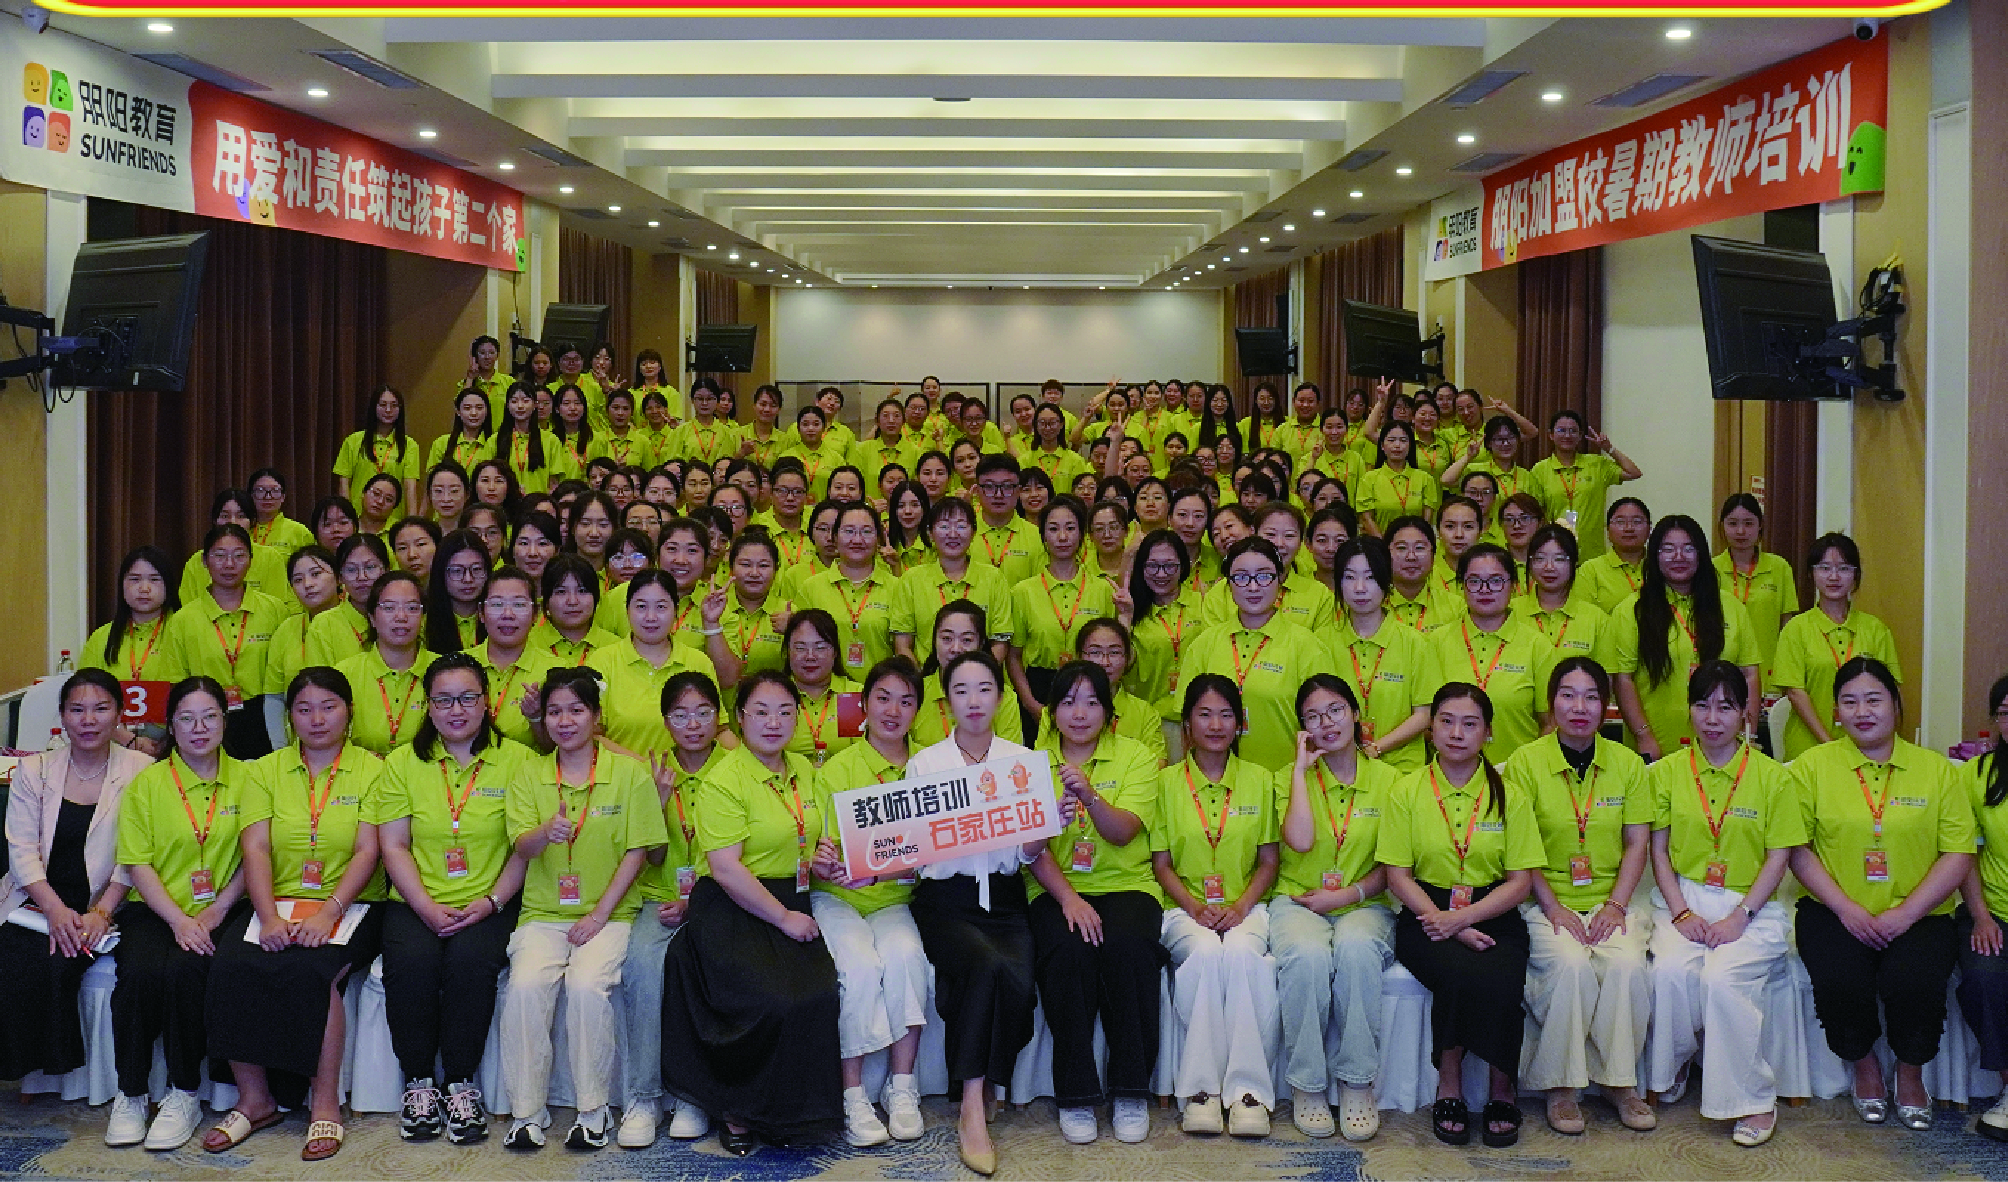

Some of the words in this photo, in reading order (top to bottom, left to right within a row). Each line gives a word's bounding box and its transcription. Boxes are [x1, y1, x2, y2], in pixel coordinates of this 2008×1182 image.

[80, 133, 177, 176] SUNFRIENDS
[212, 120, 518, 256] 用爱和责任筑起孩子第二个家
[124, 686, 147, 717] 3
[852, 777, 971, 829] 教师培训
[929, 798, 1046, 851] 石家庄站
[874, 836, 896, 849] SUN
[874, 844, 919, 861] FRIENDS
